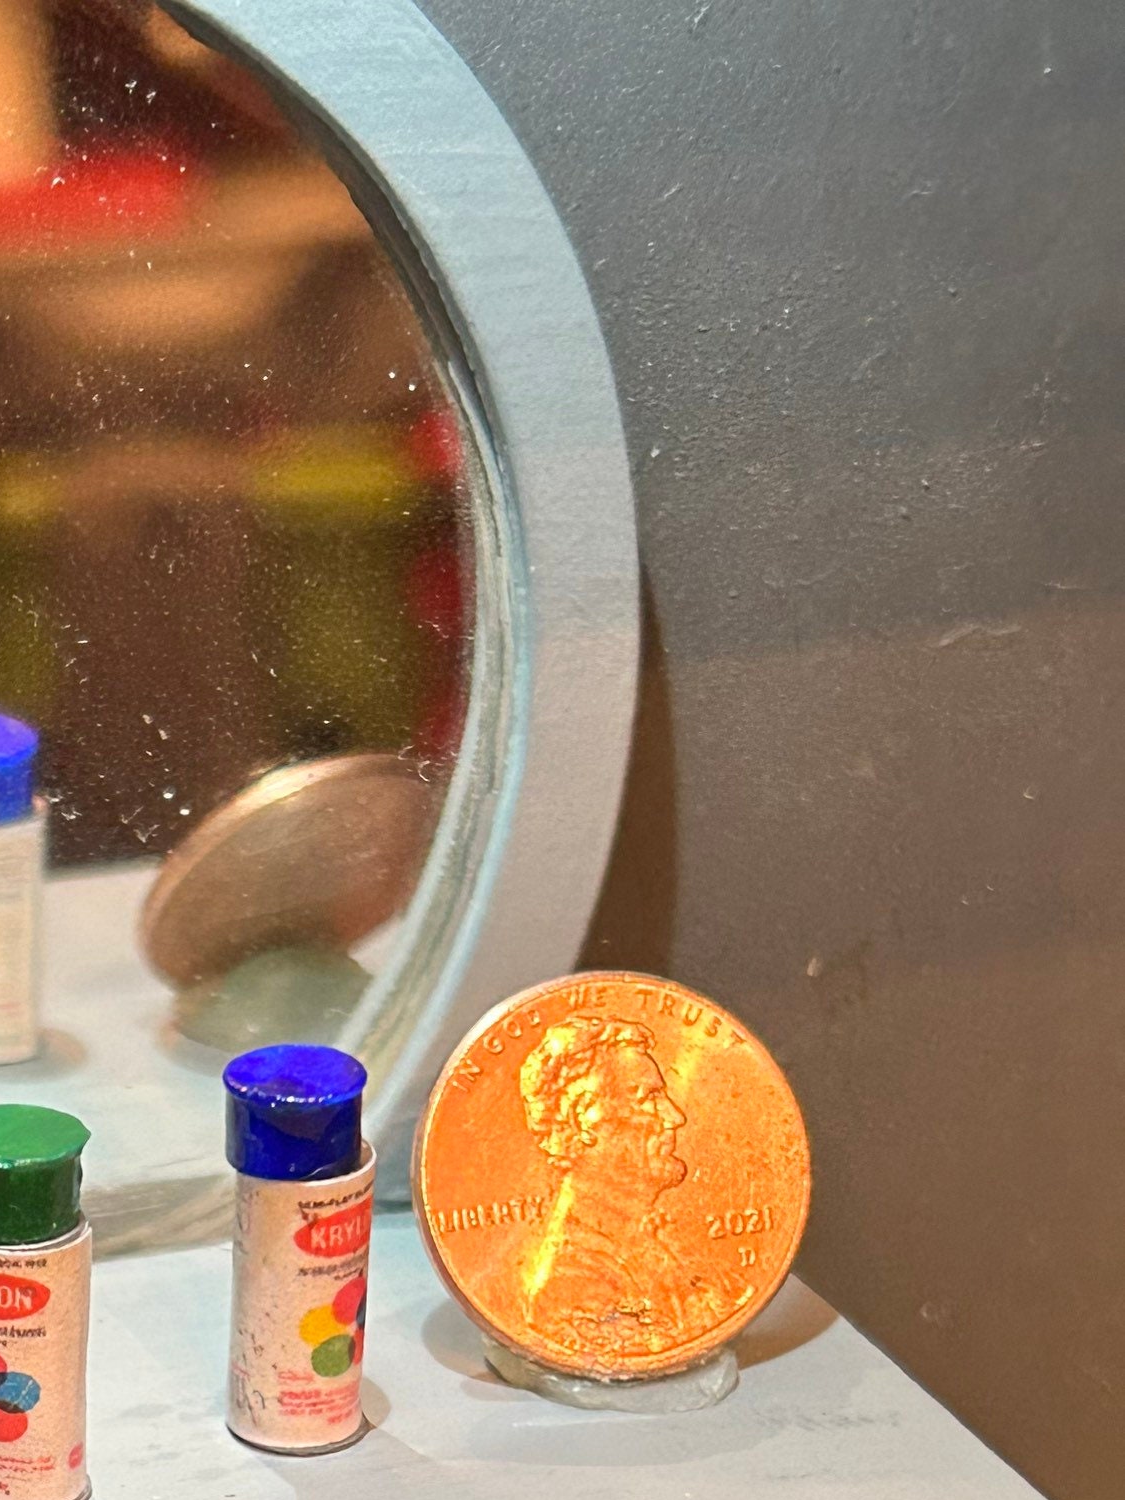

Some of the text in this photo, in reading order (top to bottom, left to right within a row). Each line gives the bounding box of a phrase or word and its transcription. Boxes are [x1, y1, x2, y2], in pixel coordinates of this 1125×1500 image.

[451, 982, 747, 1093] IN GOD WE TRUST
[437, 1195, 546, 1233] LIBERTY
[705, 1204, 774, 1240] 2021
